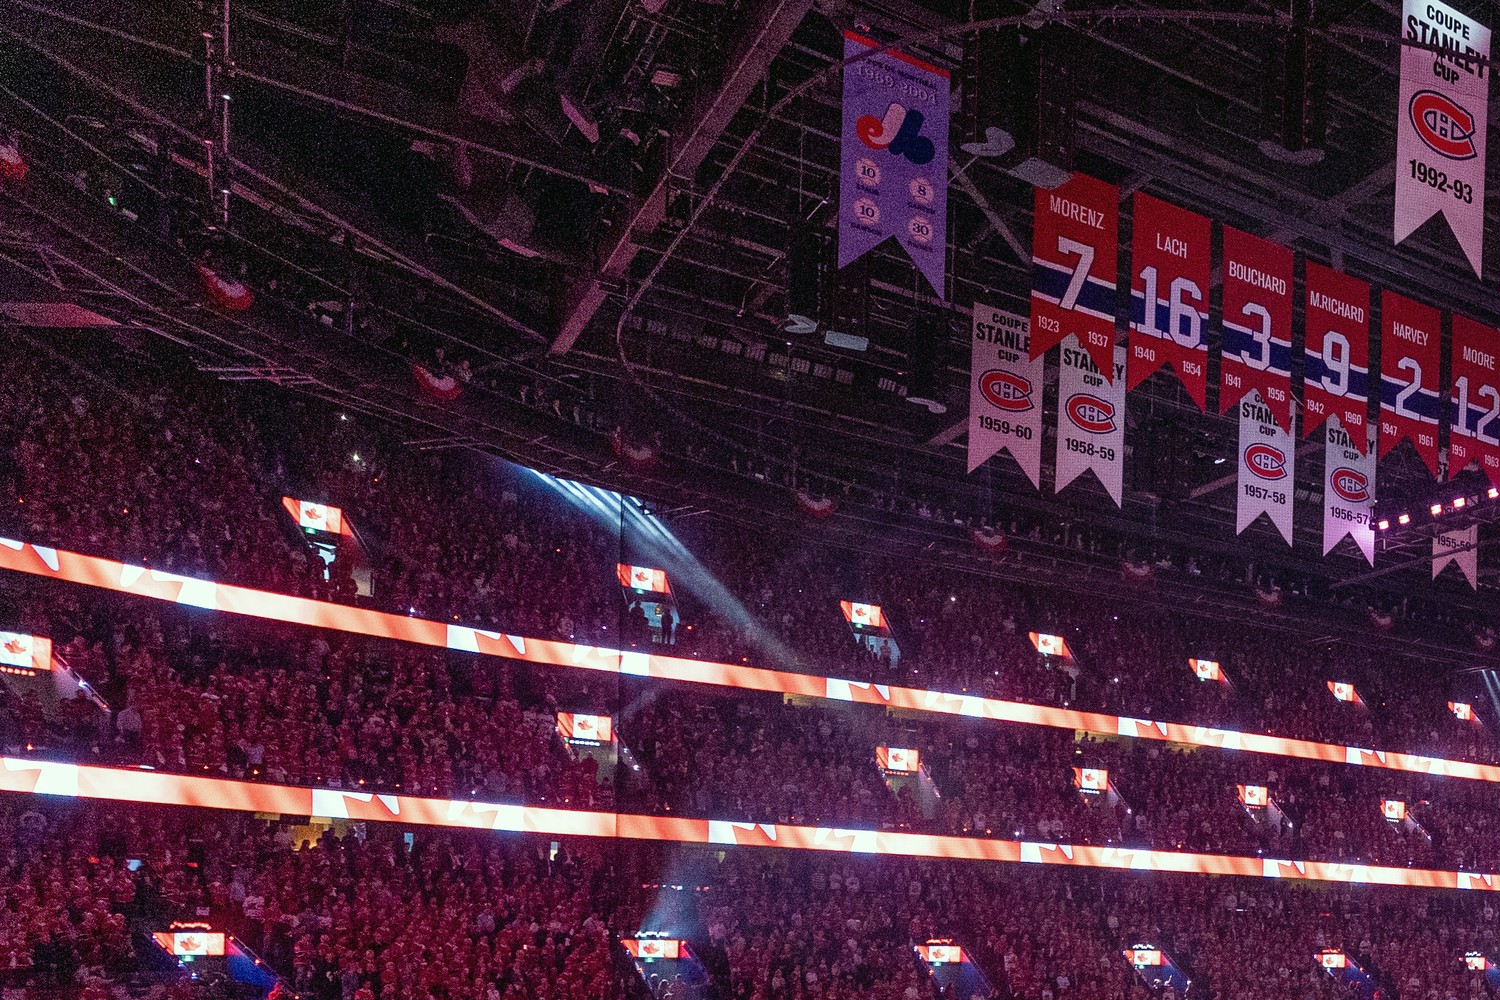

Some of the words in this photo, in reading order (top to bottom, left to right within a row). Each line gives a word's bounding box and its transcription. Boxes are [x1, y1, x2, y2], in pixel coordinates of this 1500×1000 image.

[1426, 4, 1470, 41] COUPE
[1406, 14, 1487, 79] STANLEY
[1433, 62, 1460, 85] CUP
[861, 165, 876, 178] 10
[917, 185, 927, 196] 8
[1409, 159, 1473, 205] 1992-93
[860, 205, 875, 218] 10
[1050, 195, 1105, 230] MORENZ
[912, 223, 930, 236] 30
[1156, 233, 1188, 259] LACH
[1058, 235, 1094, 310] 7
[1229, 260, 1286, 296] BOUCHARD
[1136, 265, 1202, 349] 16
[1310, 290, 1364, 324] M.RICHARD
[992, 313, 1028, 332] COUPE
[1037, 315, 1060, 333] 1923
[976, 322, 1030, 352] STANLE
[1087, 330, 1108, 348] 1937
[1240, 302, 1272, 371] 3
[1393, 320, 1429, 346] HARVEY
[998, 350, 1020, 364] CUP
[1134, 345, 1155, 362] 1940
[1463, 346, 1495, 371] MOORE
[1063, 348, 1124, 380] STANY
[1182, 360, 1201, 377] 1954
[1321, 330, 1350, 397] 9
[1083, 374, 1103, 387] CUP
[1225, 373, 1241, 389] 1941
[1395, 356, 1422, 422] 2
[1267, 386, 1285, 402] 1956
[1306, 399, 1324, 415] 1942
[1453, 376, 1500, 447] 12
[978, 415, 1032, 440] 1959-60
[1344, 411, 1362, 426] 1960
[1259, 425, 1276, 437] CUP
[1382, 422, 1398, 437] 1947
[1065, 438, 1115, 461] 1958-59
[1418, 433, 1433, 447] 1961
[1344, 450, 1359, 461] CUP
[1451, 443, 1466, 457] 1951
[1484, 454, 1499, 468] 1963
[1244, 484, 1286, 505] 1957-58
[1330, 506, 1369, 525] 1956-57
